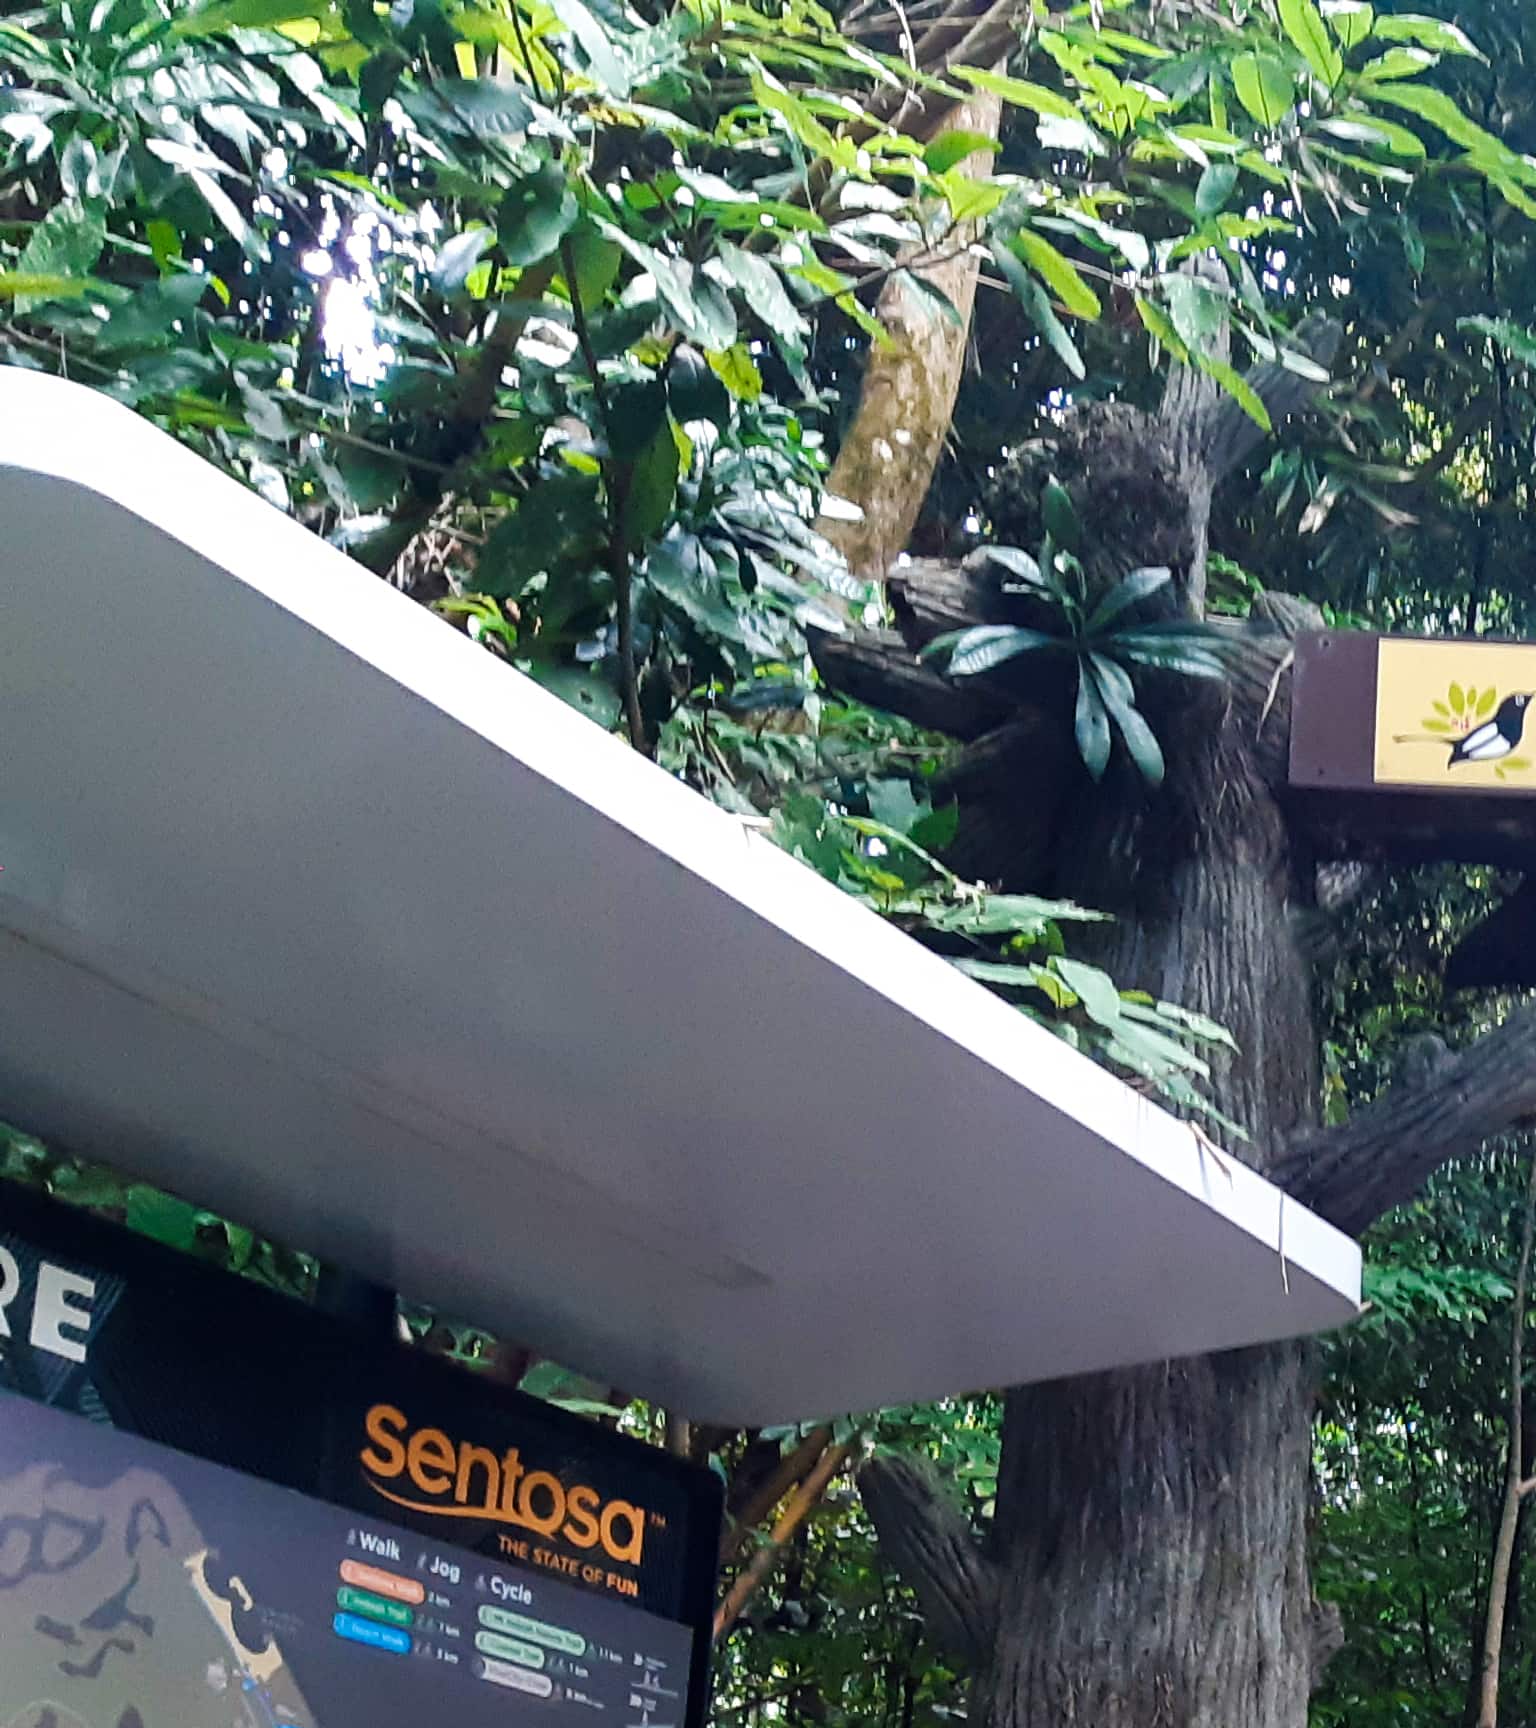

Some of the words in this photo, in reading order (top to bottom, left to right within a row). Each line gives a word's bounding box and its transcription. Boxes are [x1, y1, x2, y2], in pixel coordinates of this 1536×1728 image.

[359, 1531, 400, 1561] Walk
[429, 1555, 461, 1584] Jog
[498, 1533, 529, 1560] THE
[533, 1545, 579, 1577] STATE
[582, 1563, 604, 1583] OF
[606, 1571, 639, 1598] FUN
[490, 1575, 533, 1606] Cycle
